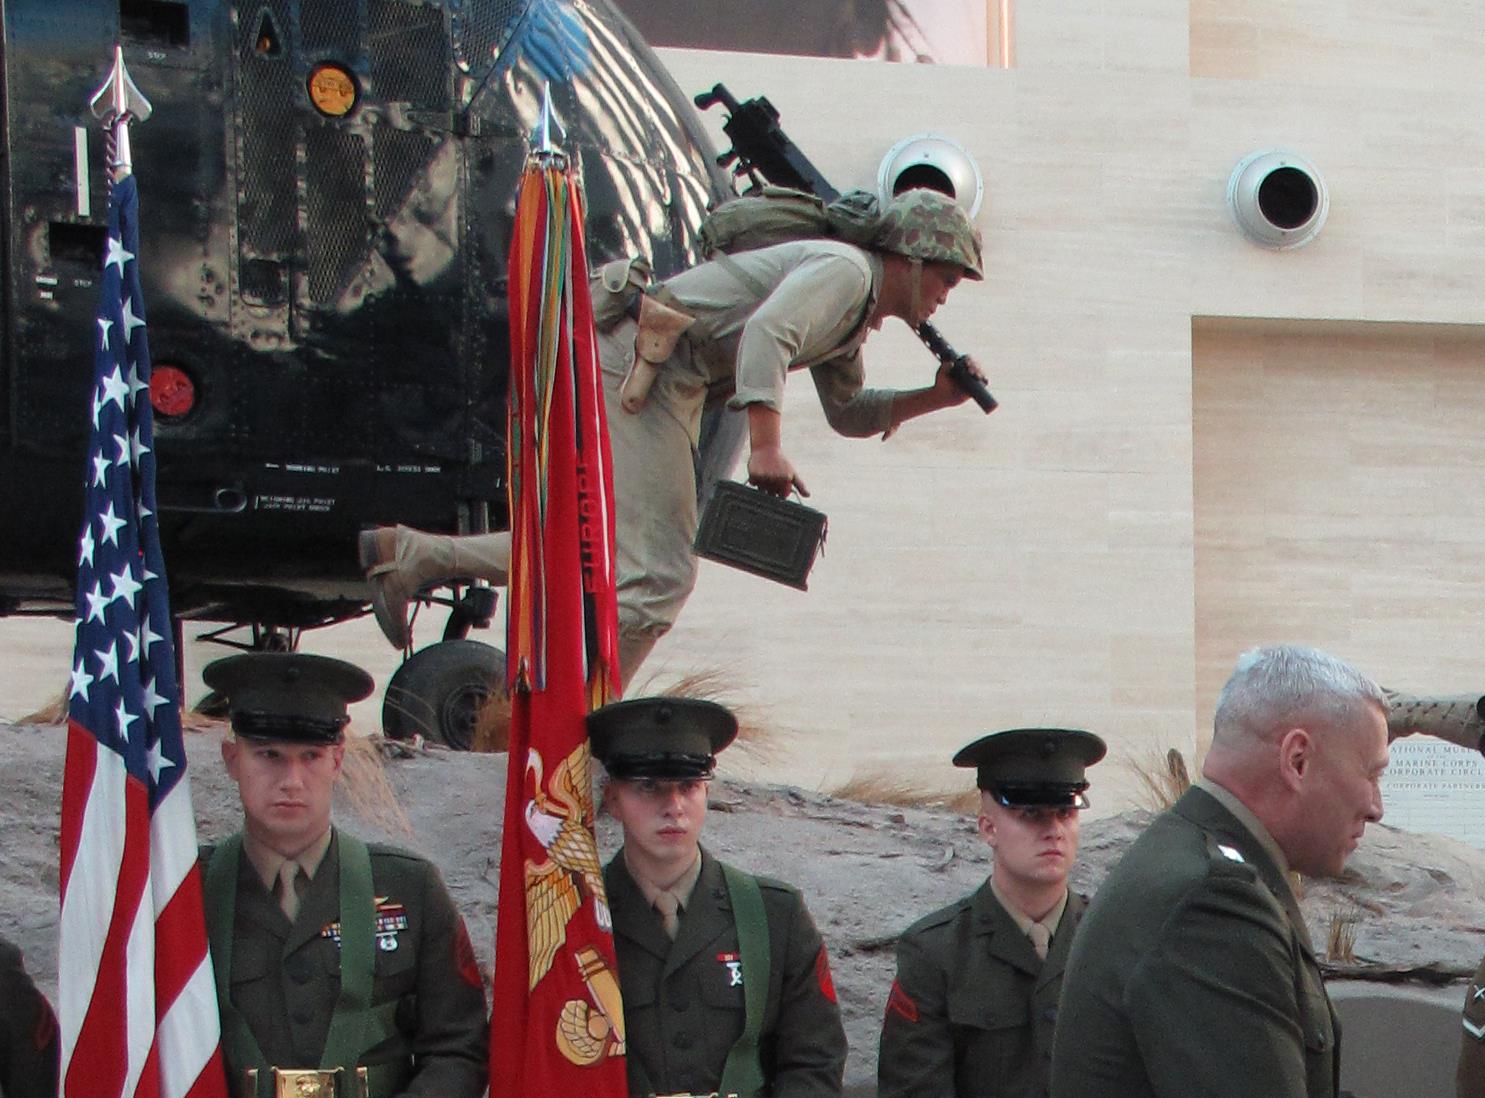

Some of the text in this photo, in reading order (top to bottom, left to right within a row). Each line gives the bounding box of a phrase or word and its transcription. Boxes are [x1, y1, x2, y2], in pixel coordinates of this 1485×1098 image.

[1391, 746, 1437, 754] ATIONAL
[1396, 759, 1478, 768] MARINE CORPS
